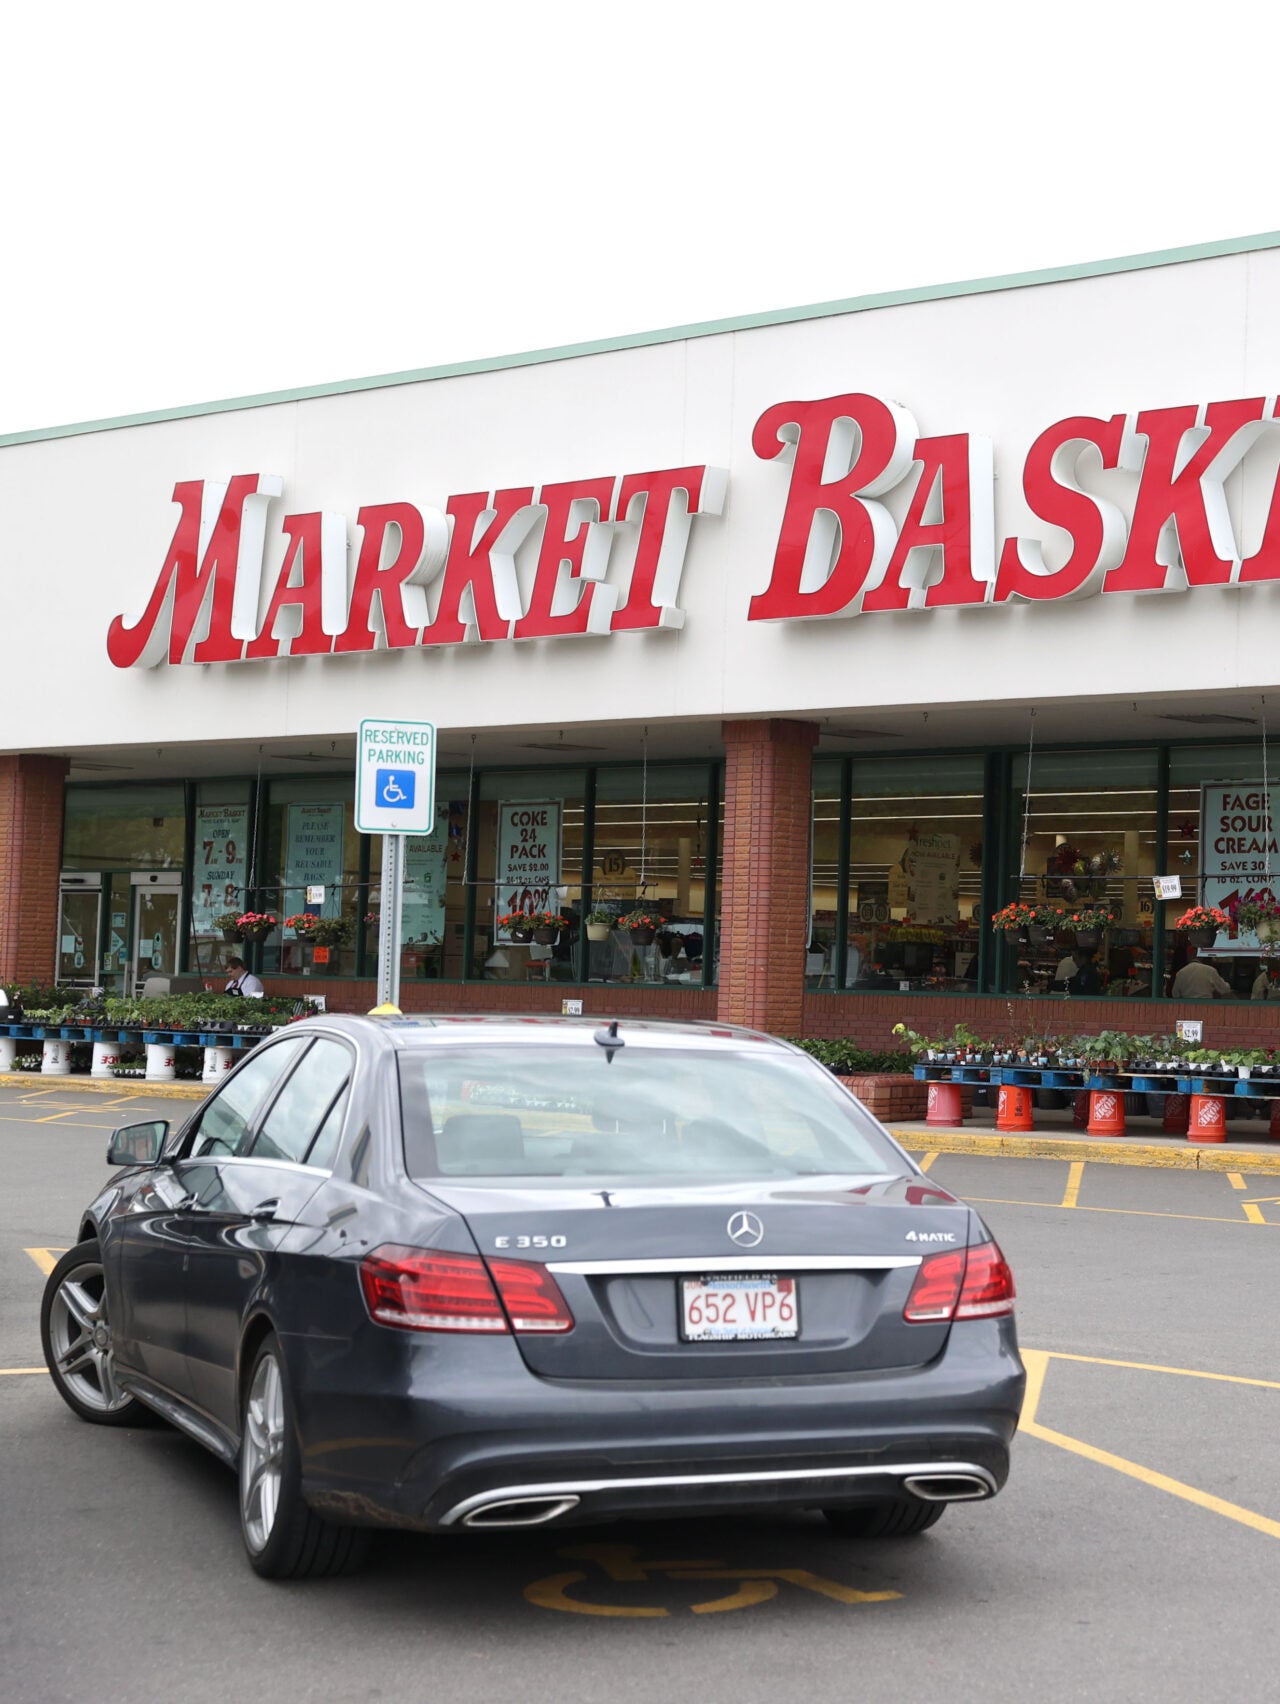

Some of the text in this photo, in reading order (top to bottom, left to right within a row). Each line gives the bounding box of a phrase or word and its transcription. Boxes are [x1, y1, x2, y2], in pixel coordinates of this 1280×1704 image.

[106, 465, 718, 669] MARKET
[365, 730, 429, 746] RESERVED
[368, 750, 424, 765] PARKING
[1222, 793, 1270, 811] FAGE
[510, 811, 548, 826] COKE
[1220, 816, 1272, 832] SOUR
[302, 822, 329, 830] PLEASE
[213, 830, 230, 838] OPEN
[295, 834, 336, 843] REMEMBER
[520, 828, 536, 842] 24
[305, 848, 325, 856] YOUR
[510, 844, 547, 859] PACK
[1214, 837, 1278, 854] CREAM
[295, 860, 333, 868] REUSABLE
[508, 863, 549, 872] SAVE $2.00
[1221, 861, 1248, 870] SAVE
[207, 871, 235, 880] SUNDAY
[1140, 901, 1150, 912] 16
[495, 1235, 566, 1248] E 350
[688, 1292, 793, 1324] 652 VP6
